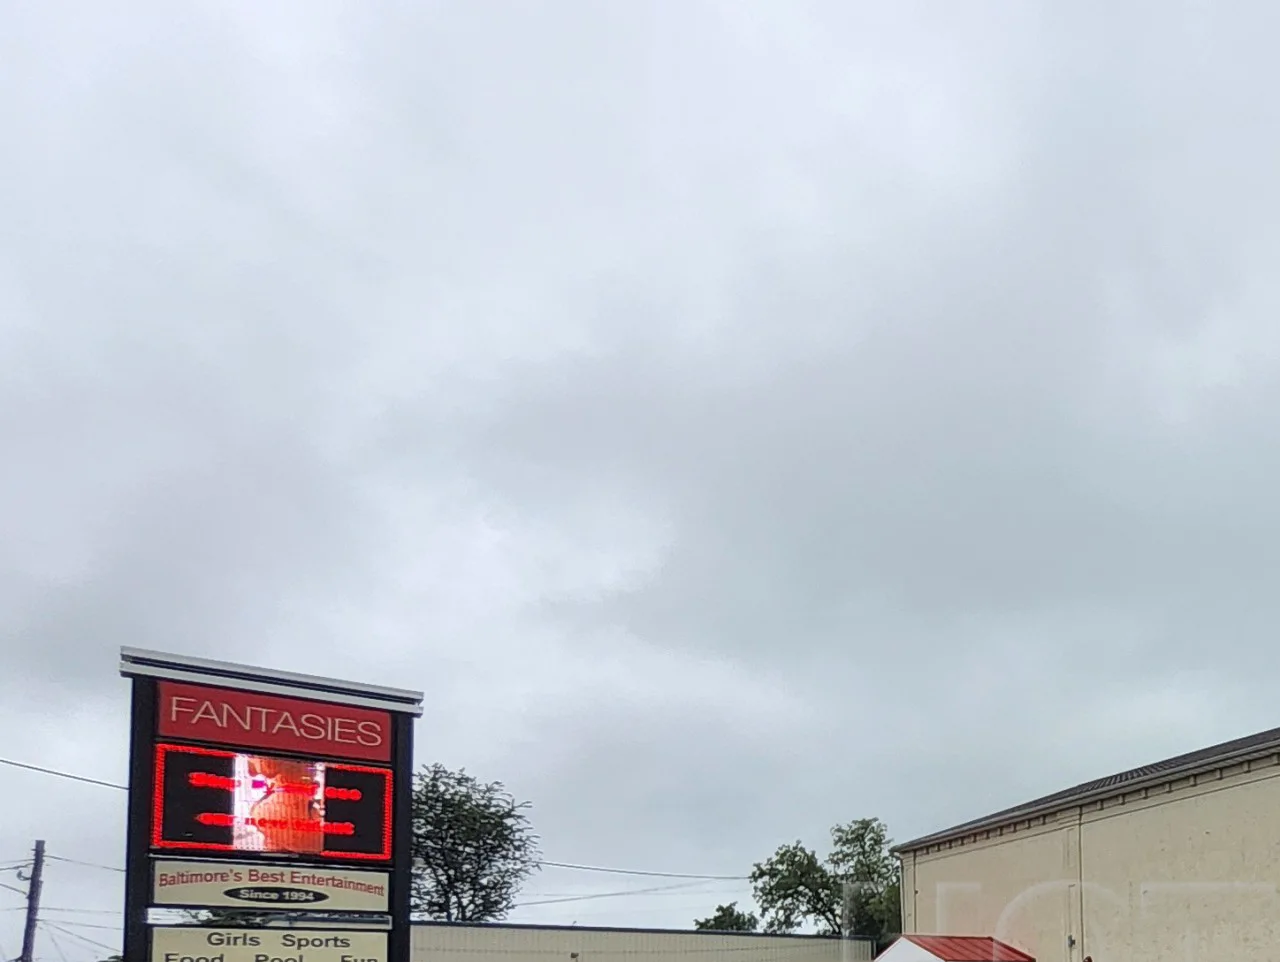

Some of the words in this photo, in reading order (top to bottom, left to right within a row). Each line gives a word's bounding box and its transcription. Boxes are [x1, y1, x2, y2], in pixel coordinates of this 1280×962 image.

[171, 696, 382, 747] FANTASIES
[159, 868, 243, 888] Baltimore's
[248, 868, 286, 884] Best
[290, 871, 385, 897] Entertainment
[239, 889, 280, 900] Since
[282, 890, 315, 901] 1994
[206, 931, 261, 947] Girls
[281, 934, 350, 950] Sports
